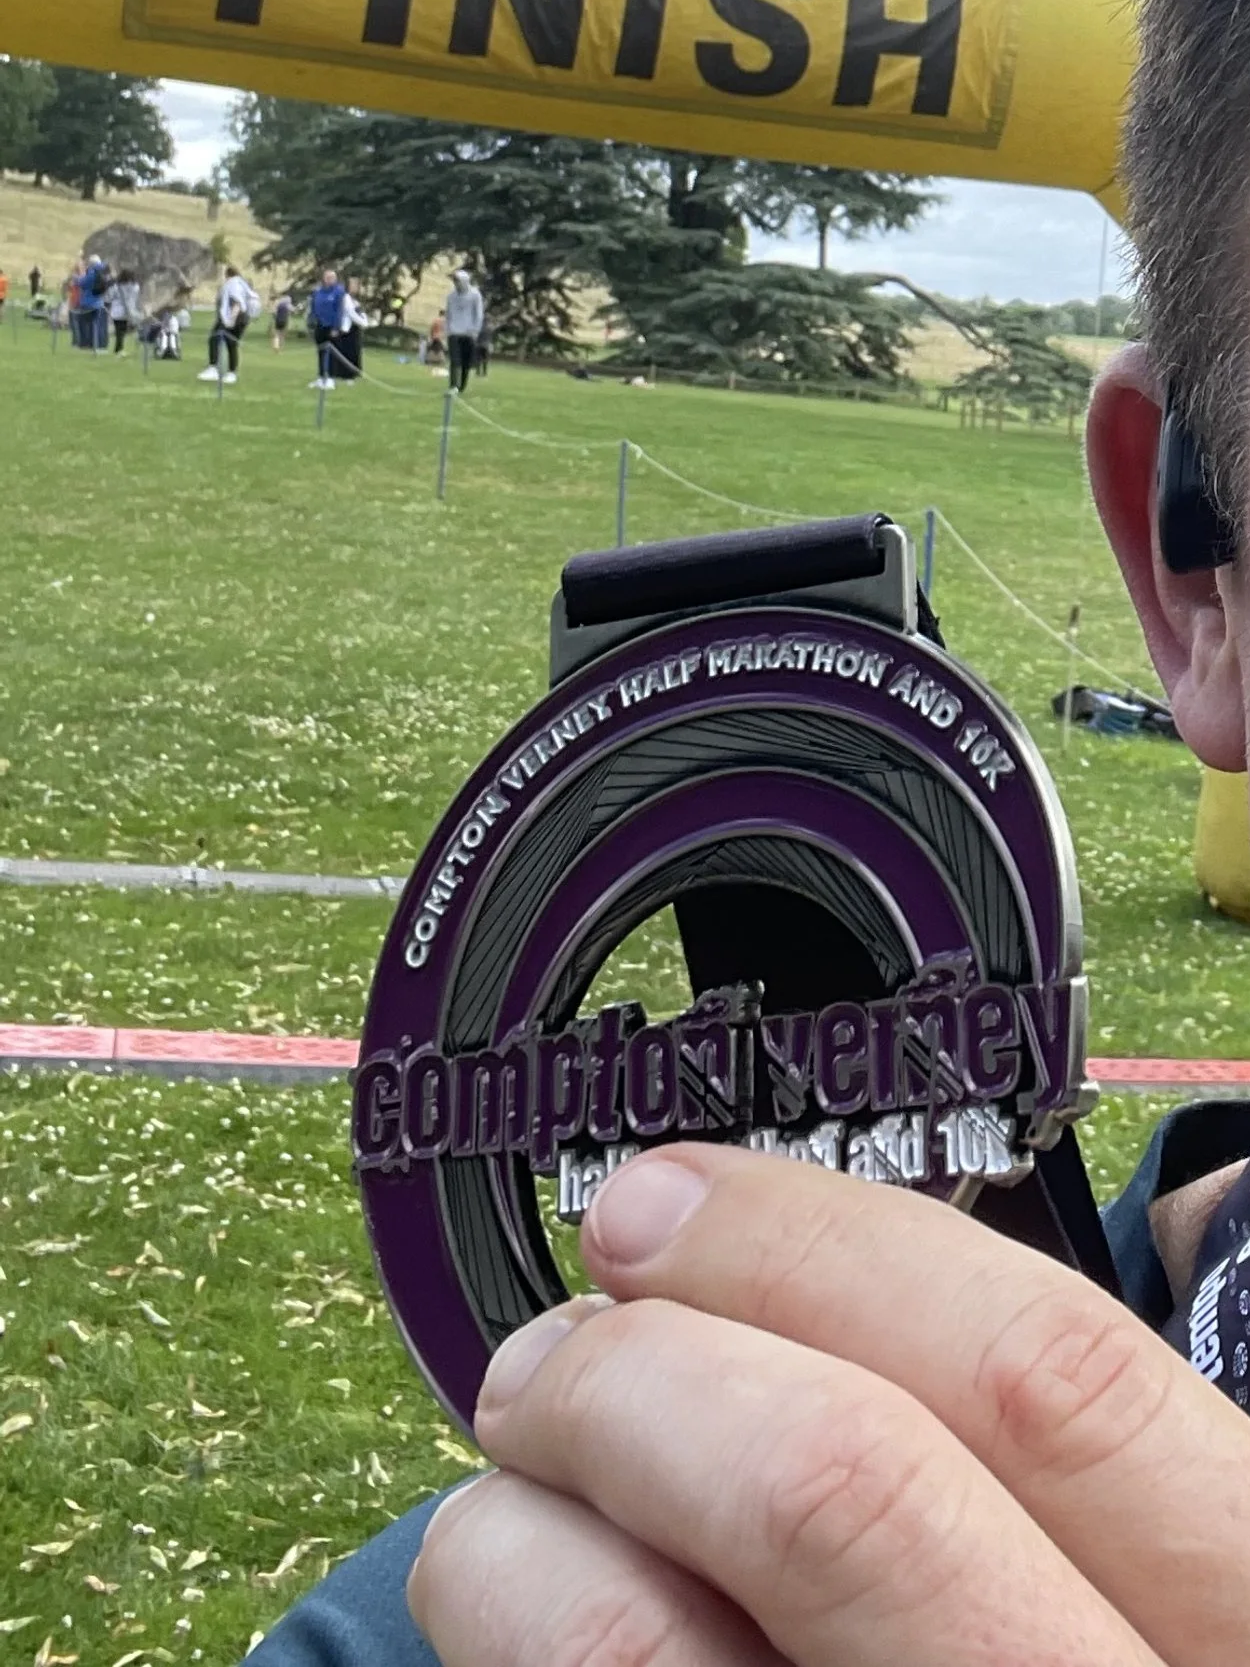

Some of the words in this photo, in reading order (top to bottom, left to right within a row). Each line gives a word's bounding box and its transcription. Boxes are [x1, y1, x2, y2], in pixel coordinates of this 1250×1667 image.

[405, 790, 513, 968] COMPTON
[501, 688, 612, 791] VERNEY
[617, 647, 702, 708] HALF
[705, 636, 893, 688] MARATHON
[888, 663, 964, 729] AND
[952, 719, 1018, 793] 10K
[352, 1014, 742, 1174] compton
[759, 984, 1086, 1129] verney
[937, 1107, 1016, 1176] 10K
